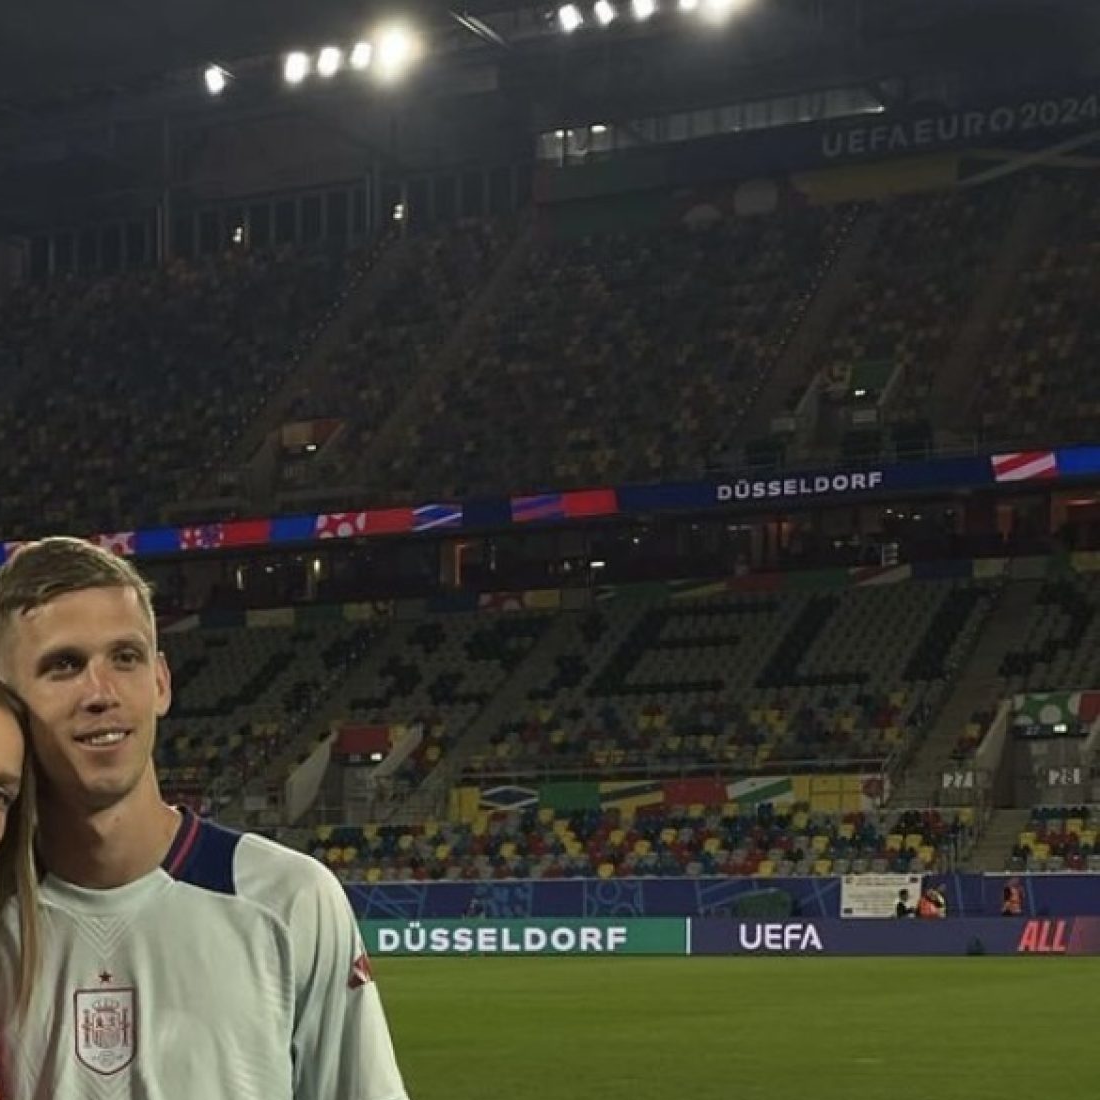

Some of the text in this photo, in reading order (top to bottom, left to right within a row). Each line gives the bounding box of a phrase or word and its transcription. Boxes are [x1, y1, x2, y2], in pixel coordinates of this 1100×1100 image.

[716, 471, 883, 500] DÜSSELDORF
[377, 921, 627, 952] DÜSSELDORF
[739, 923, 822, 950] UEFA
[1018, 920, 1067, 952] ALL
